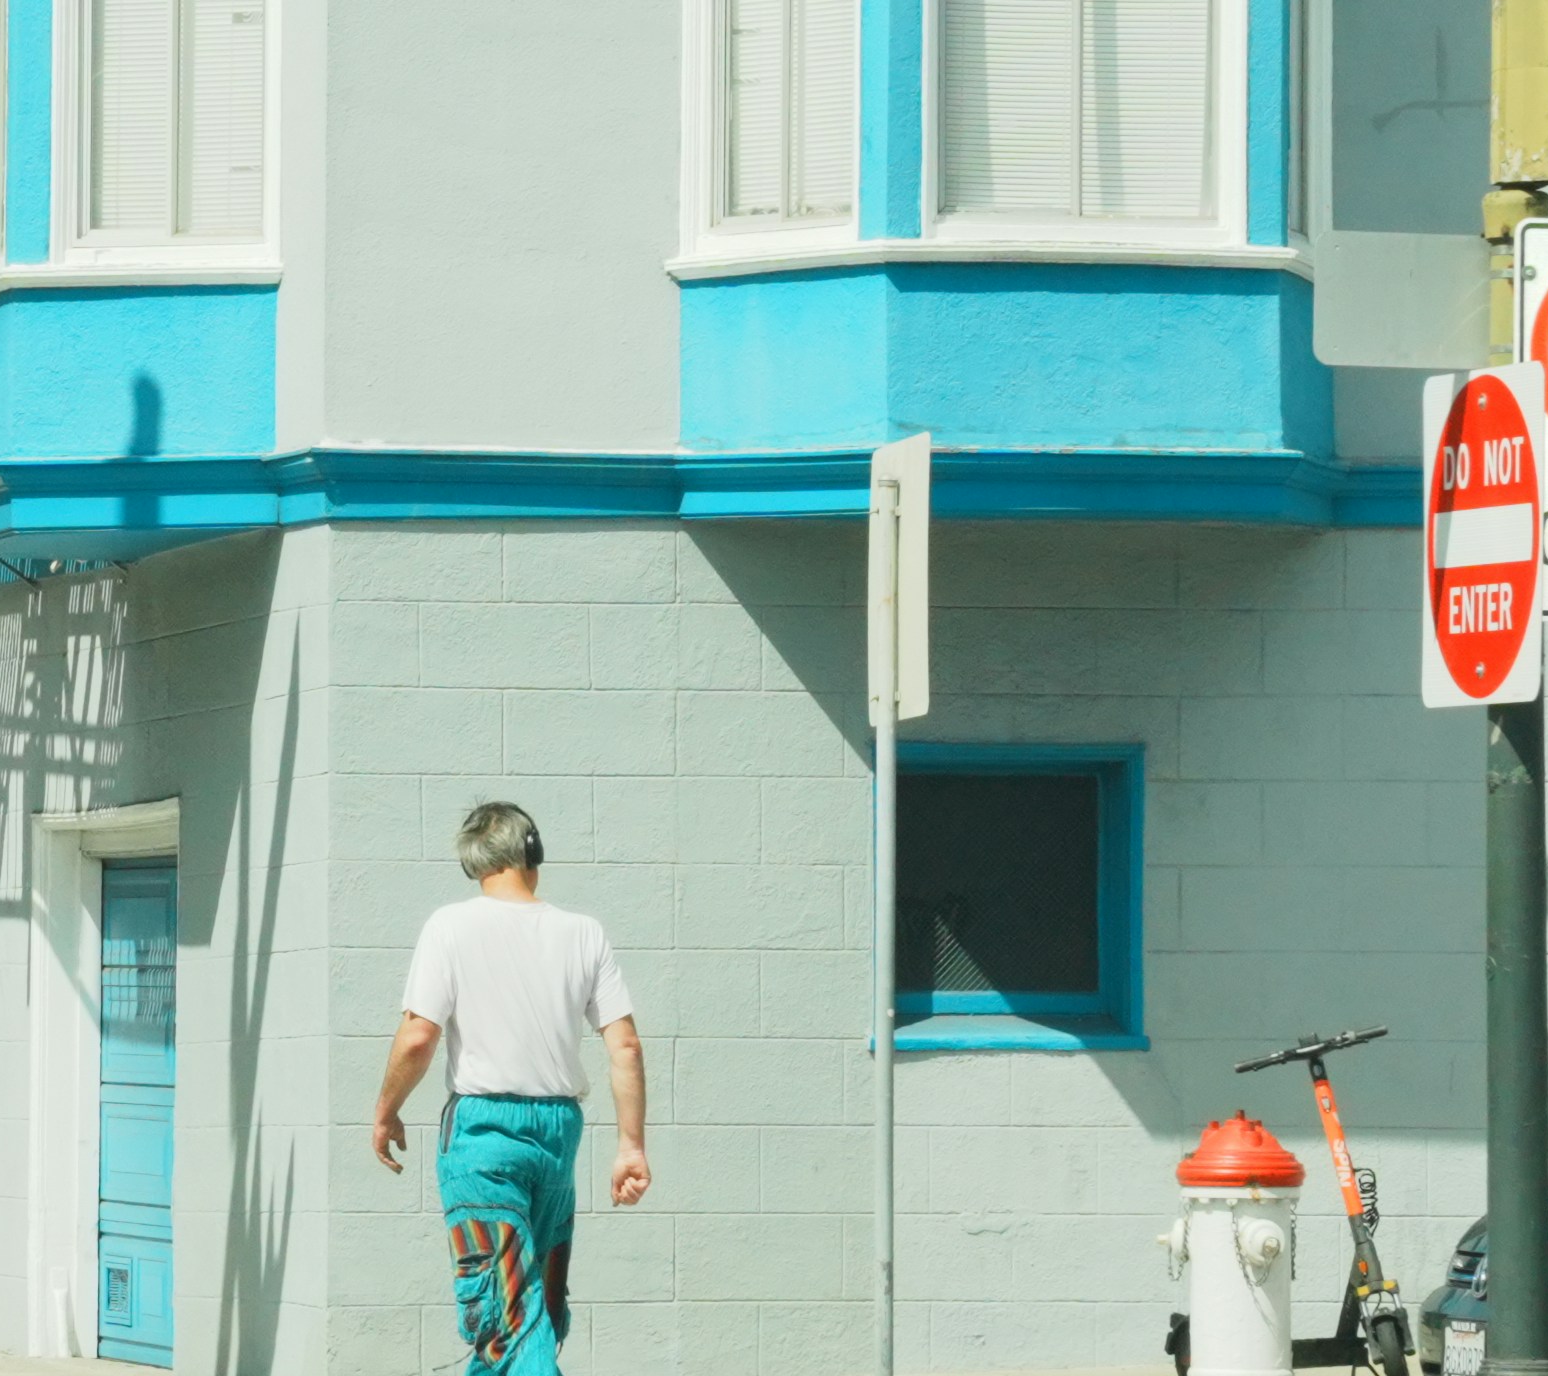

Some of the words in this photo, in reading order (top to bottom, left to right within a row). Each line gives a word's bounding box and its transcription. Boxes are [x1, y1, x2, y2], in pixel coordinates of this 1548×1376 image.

[1442, 444, 1470, 491] DO
[1483, 435, 1524, 488] NOT
[1448, 582, 1513, 635] ENTER
[1332, 1138, 1352, 1188] SPIN
